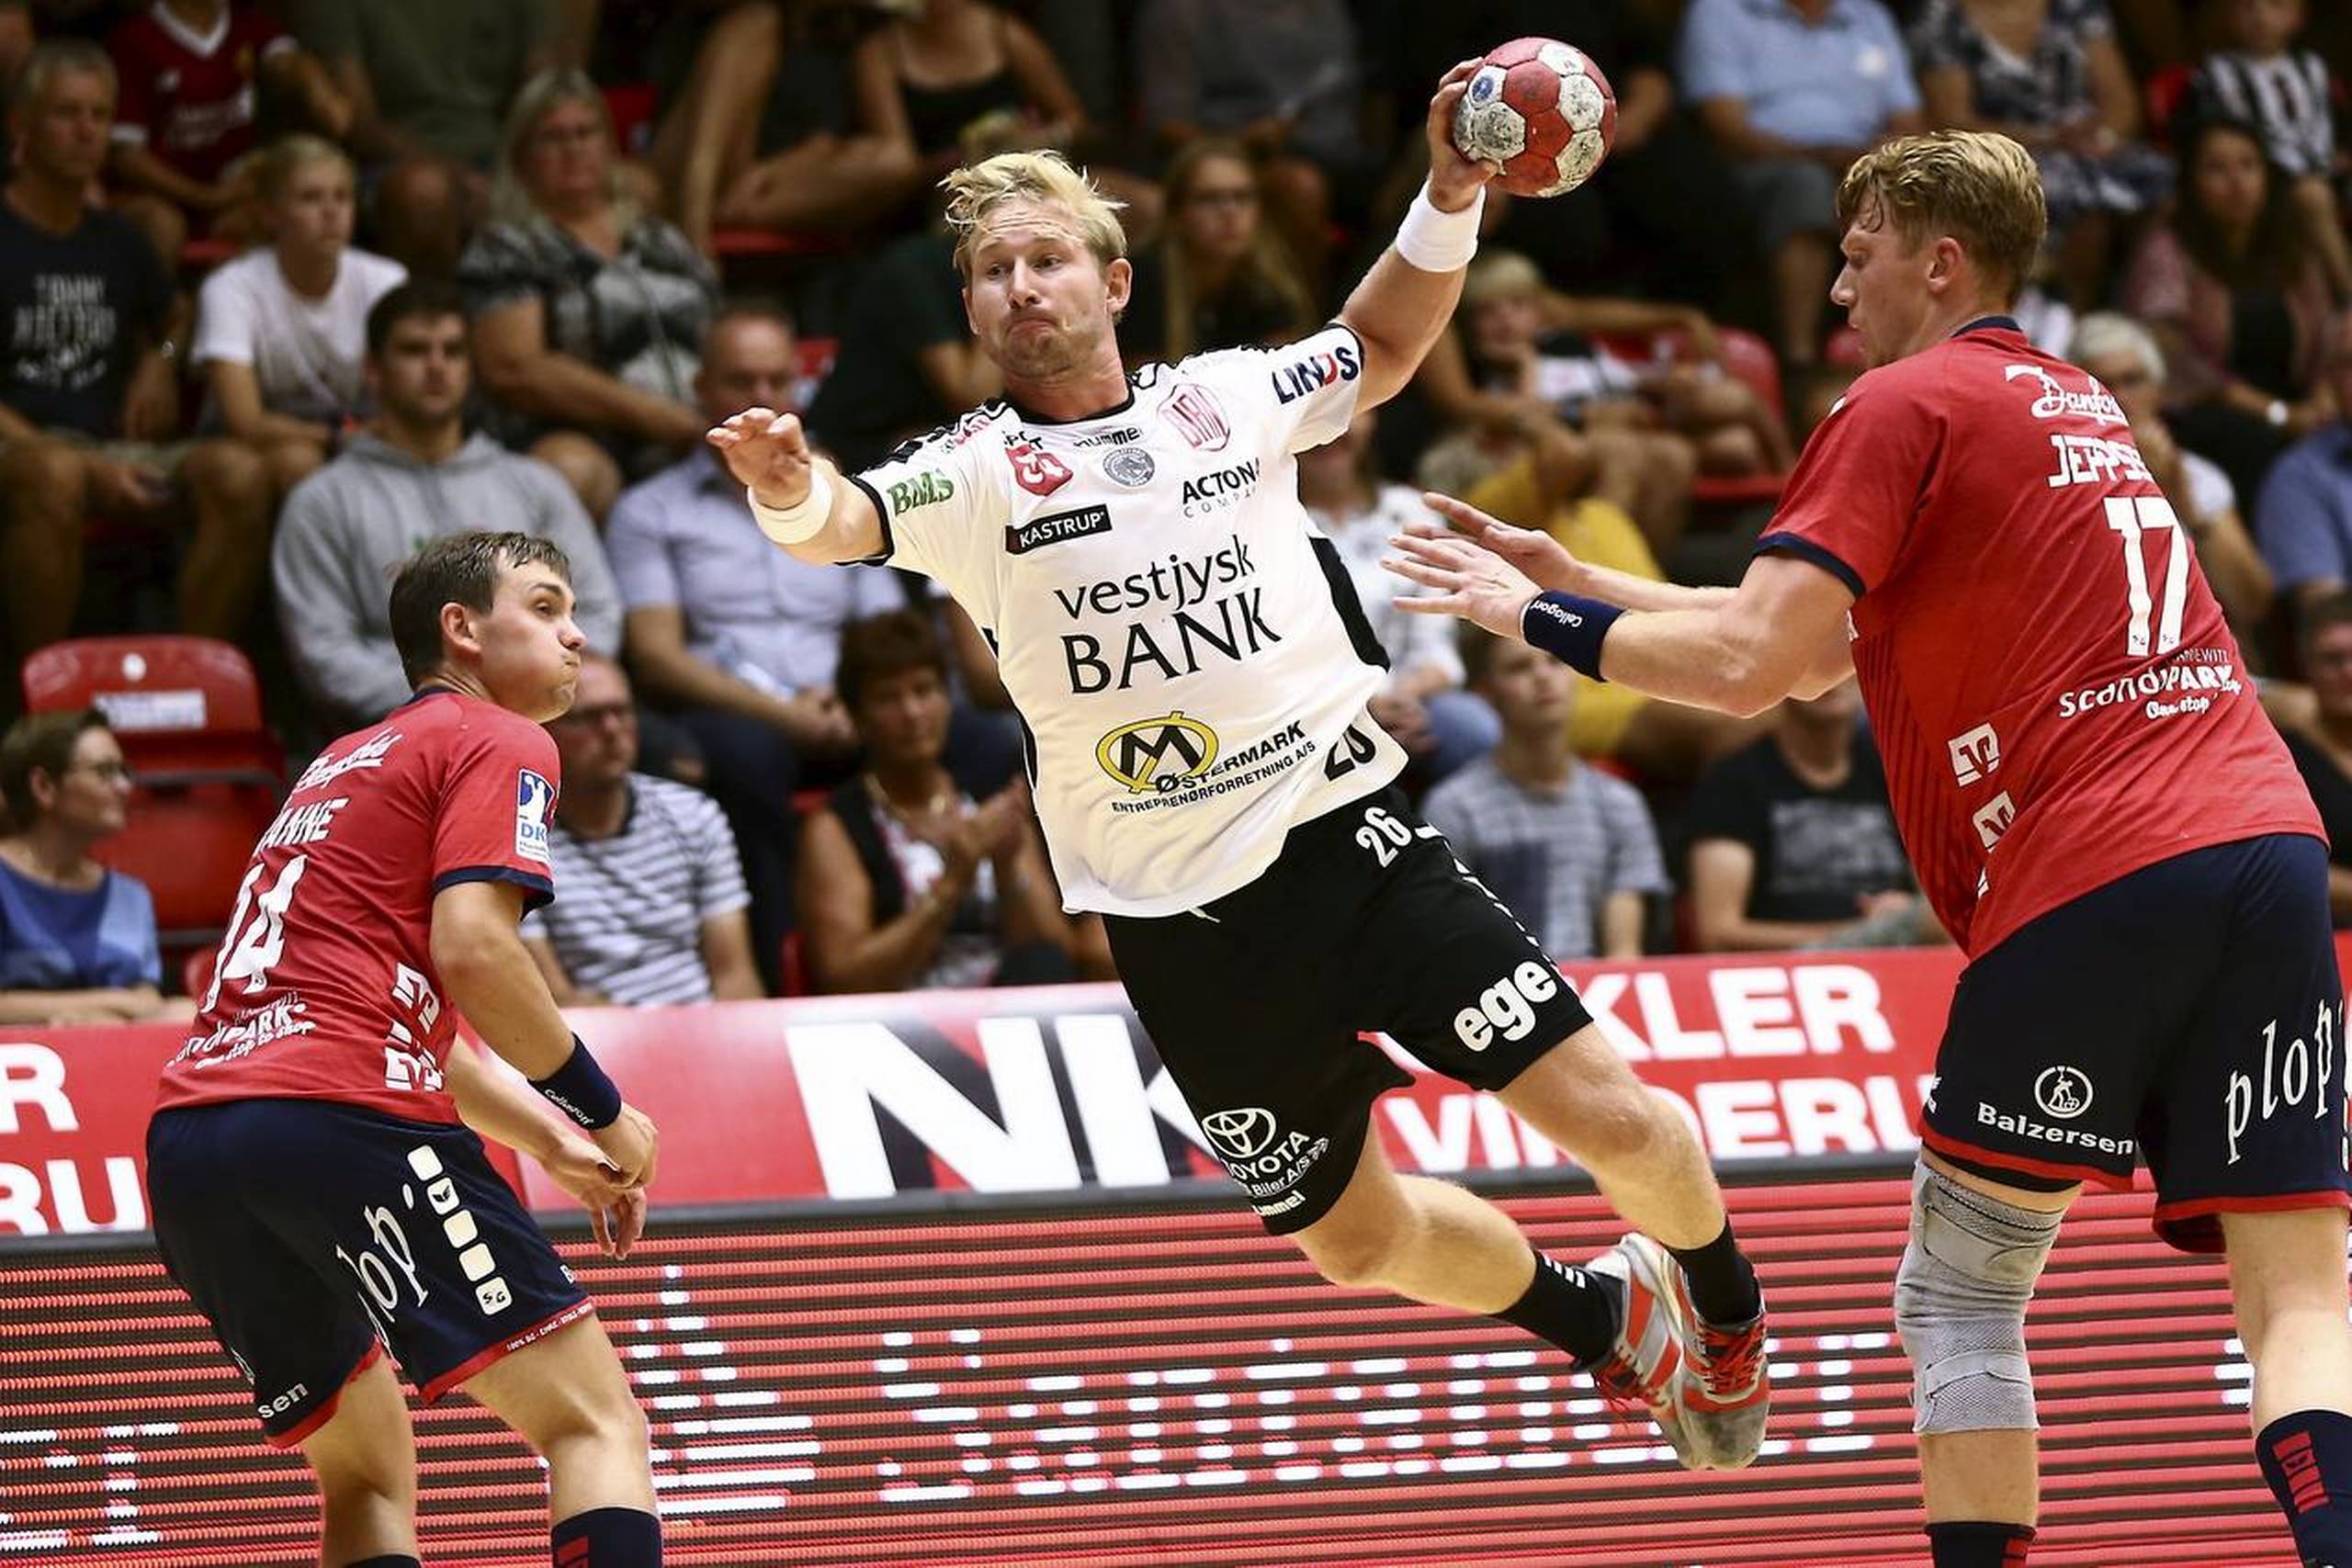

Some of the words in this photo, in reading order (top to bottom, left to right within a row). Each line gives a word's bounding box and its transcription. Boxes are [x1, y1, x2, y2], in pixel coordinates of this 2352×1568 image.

[1019, 512, 1104, 548] KASTRUP
[1054, 535, 1255, 619] vestjysk
[2103, 496, 2189, 656] 17
[1060, 588, 1283, 694] BANK
[1155, 720, 1306, 794] ØSTERMARK
[1295, 742, 1316, 761] A/S
[1355, 807, 1412, 868] 26
[200, 854, 308, 1013] 14
[1453, 961, 1557, 1052] ege
[1977, 1102, 2133, 1155] Balzersen
[1251, 1178, 1286, 1196] Biler
[878, 1328, 1893, 1503] Santanr
